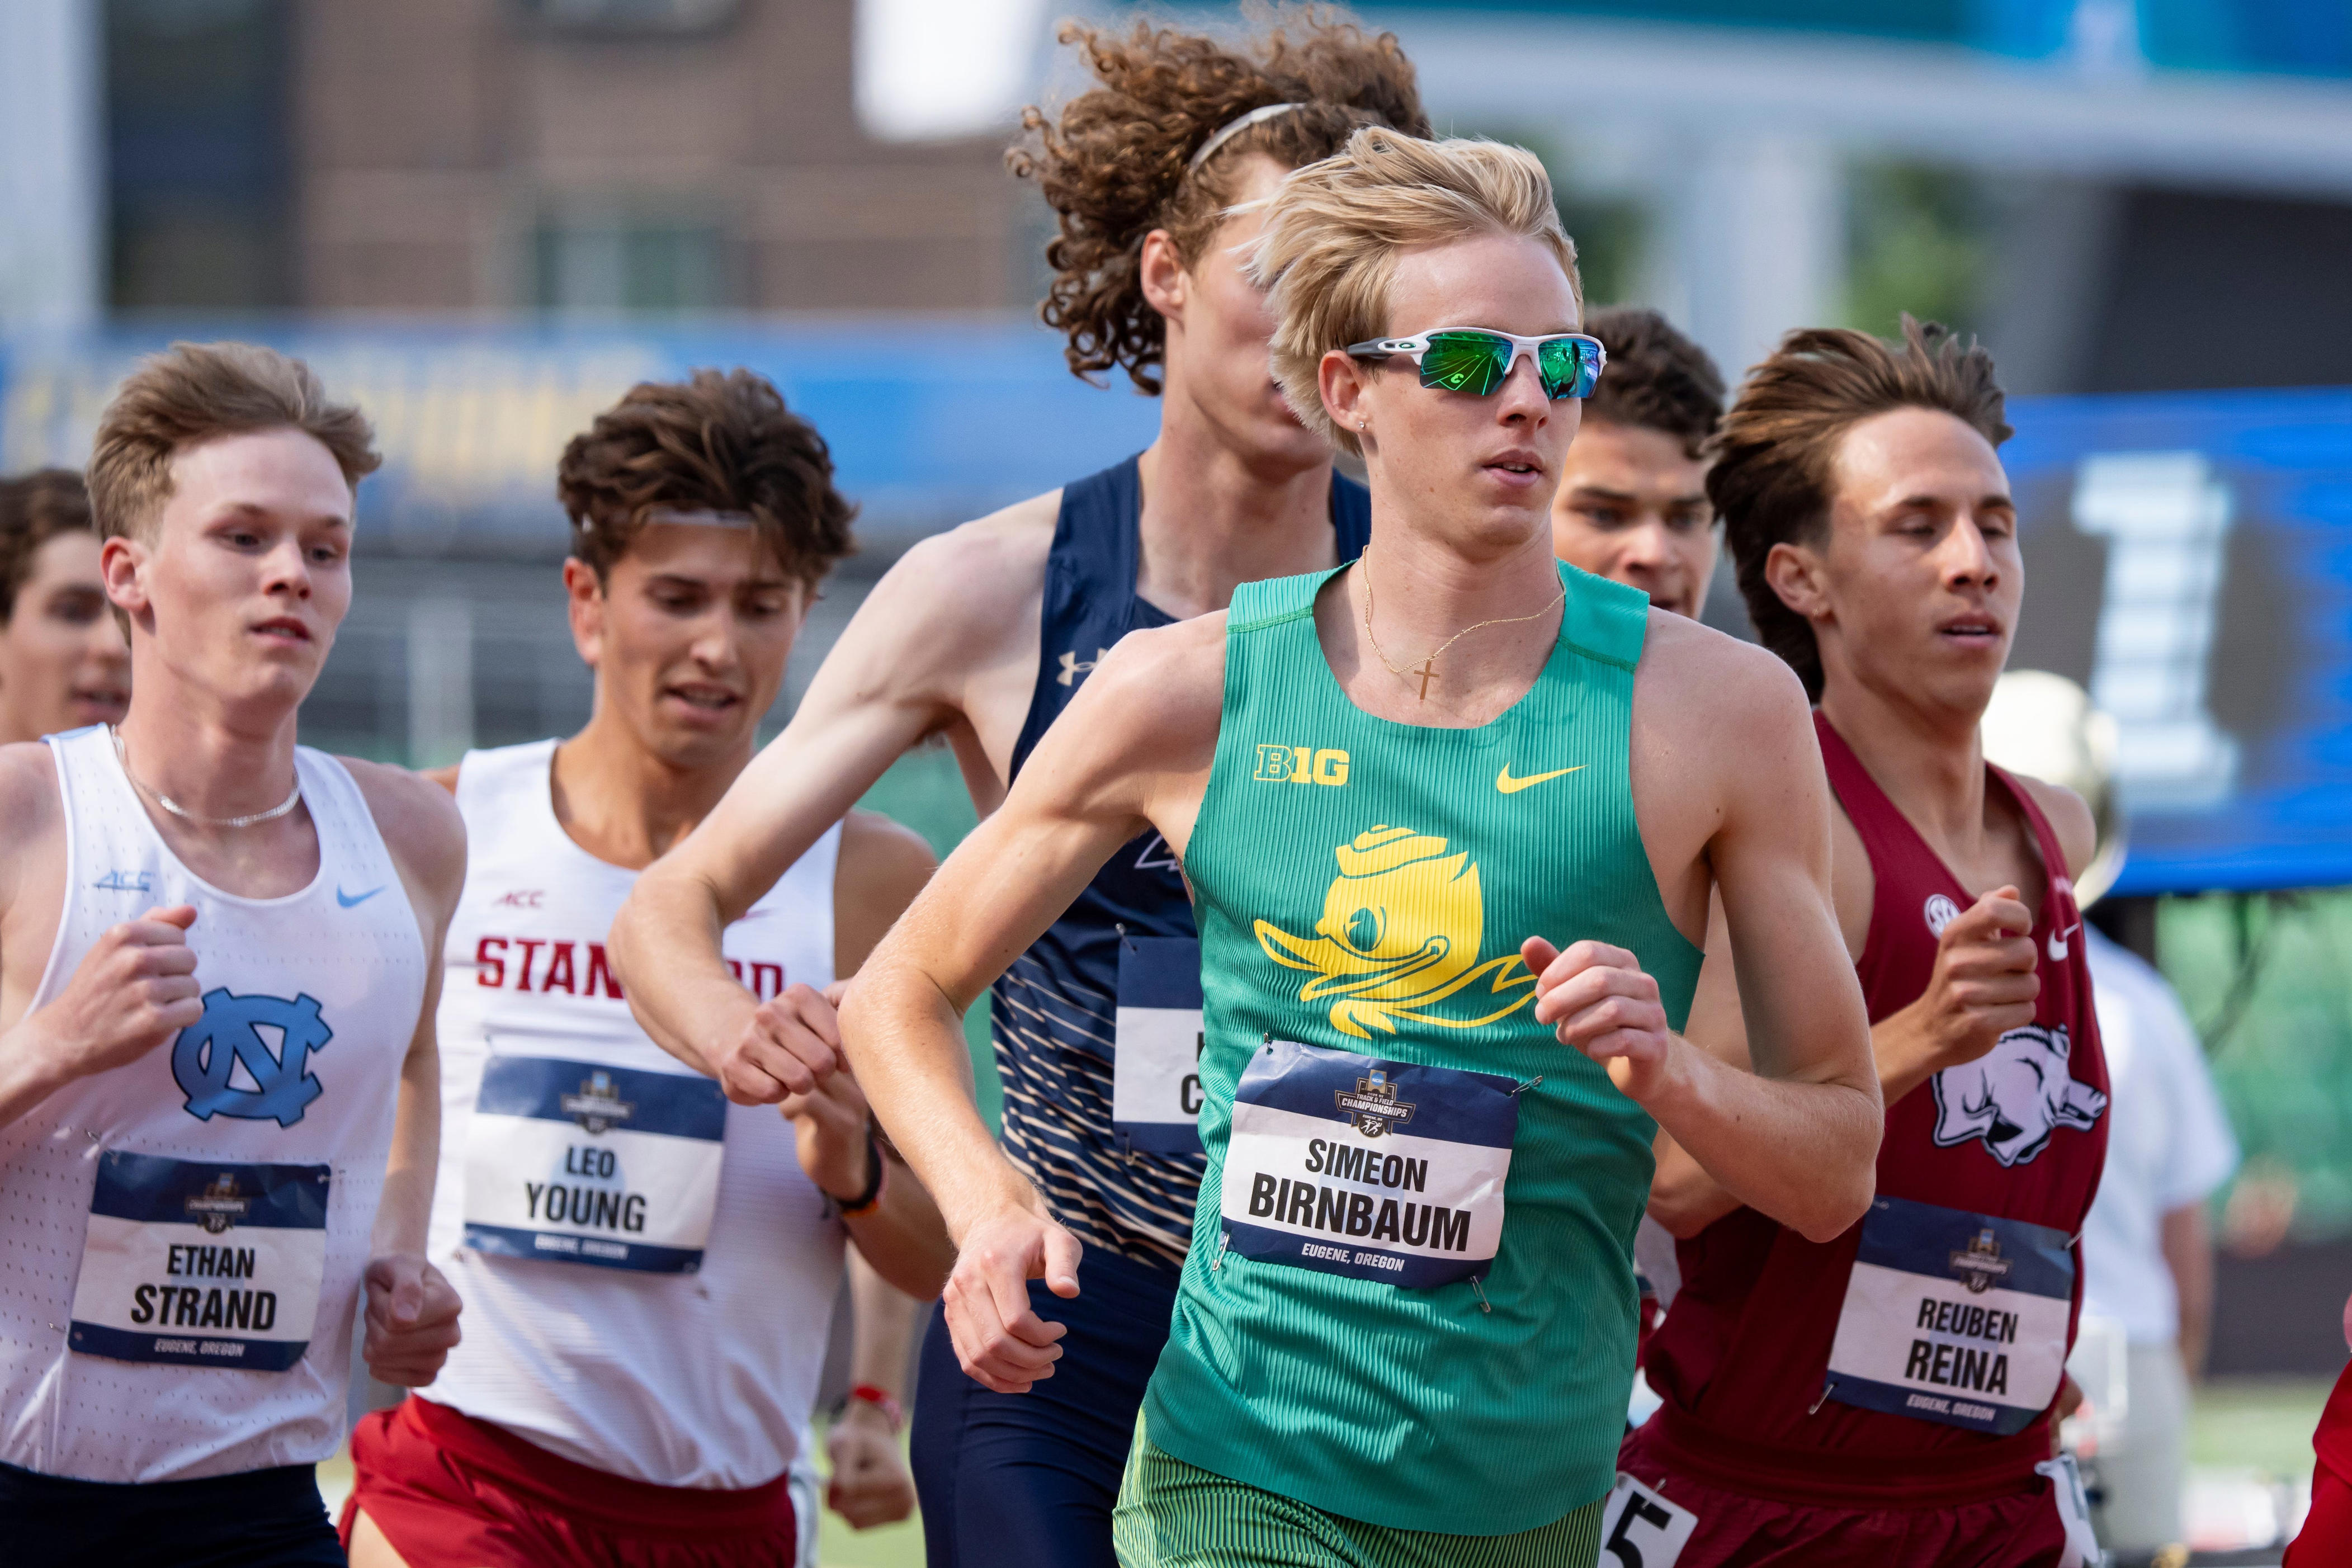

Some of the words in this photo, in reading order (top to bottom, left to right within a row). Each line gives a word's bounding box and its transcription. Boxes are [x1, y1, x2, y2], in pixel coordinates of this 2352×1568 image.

[2072, 451, 2235, 815] 1
[93, 870, 154, 891] ACC
[492, 890, 545, 908] ACC
[1342, 1097, 1408, 1117] CHAMPIONSHIPS
[1356, 1093, 1374, 1102] TRACK
[1379, 1098, 1394, 1106] FIELD
[566, 1145, 615, 1178] LEO
[1305, 1138, 1429, 1193] SIMEON
[526, 1182, 646, 1231] YOUNG
[1248, 1172, 1471, 1252] BIRNBAUM
[167, 1244, 256, 1278] ETHAN
[1301, 1243, 1351, 1264] EUGENE,
[1354, 1252, 1405, 1272] OREGON
[130, 1284, 277, 1331] STRAND
[1916, 1298, 2019, 1344] REUBEN
[1905, 1339, 2009, 1396] REINA
